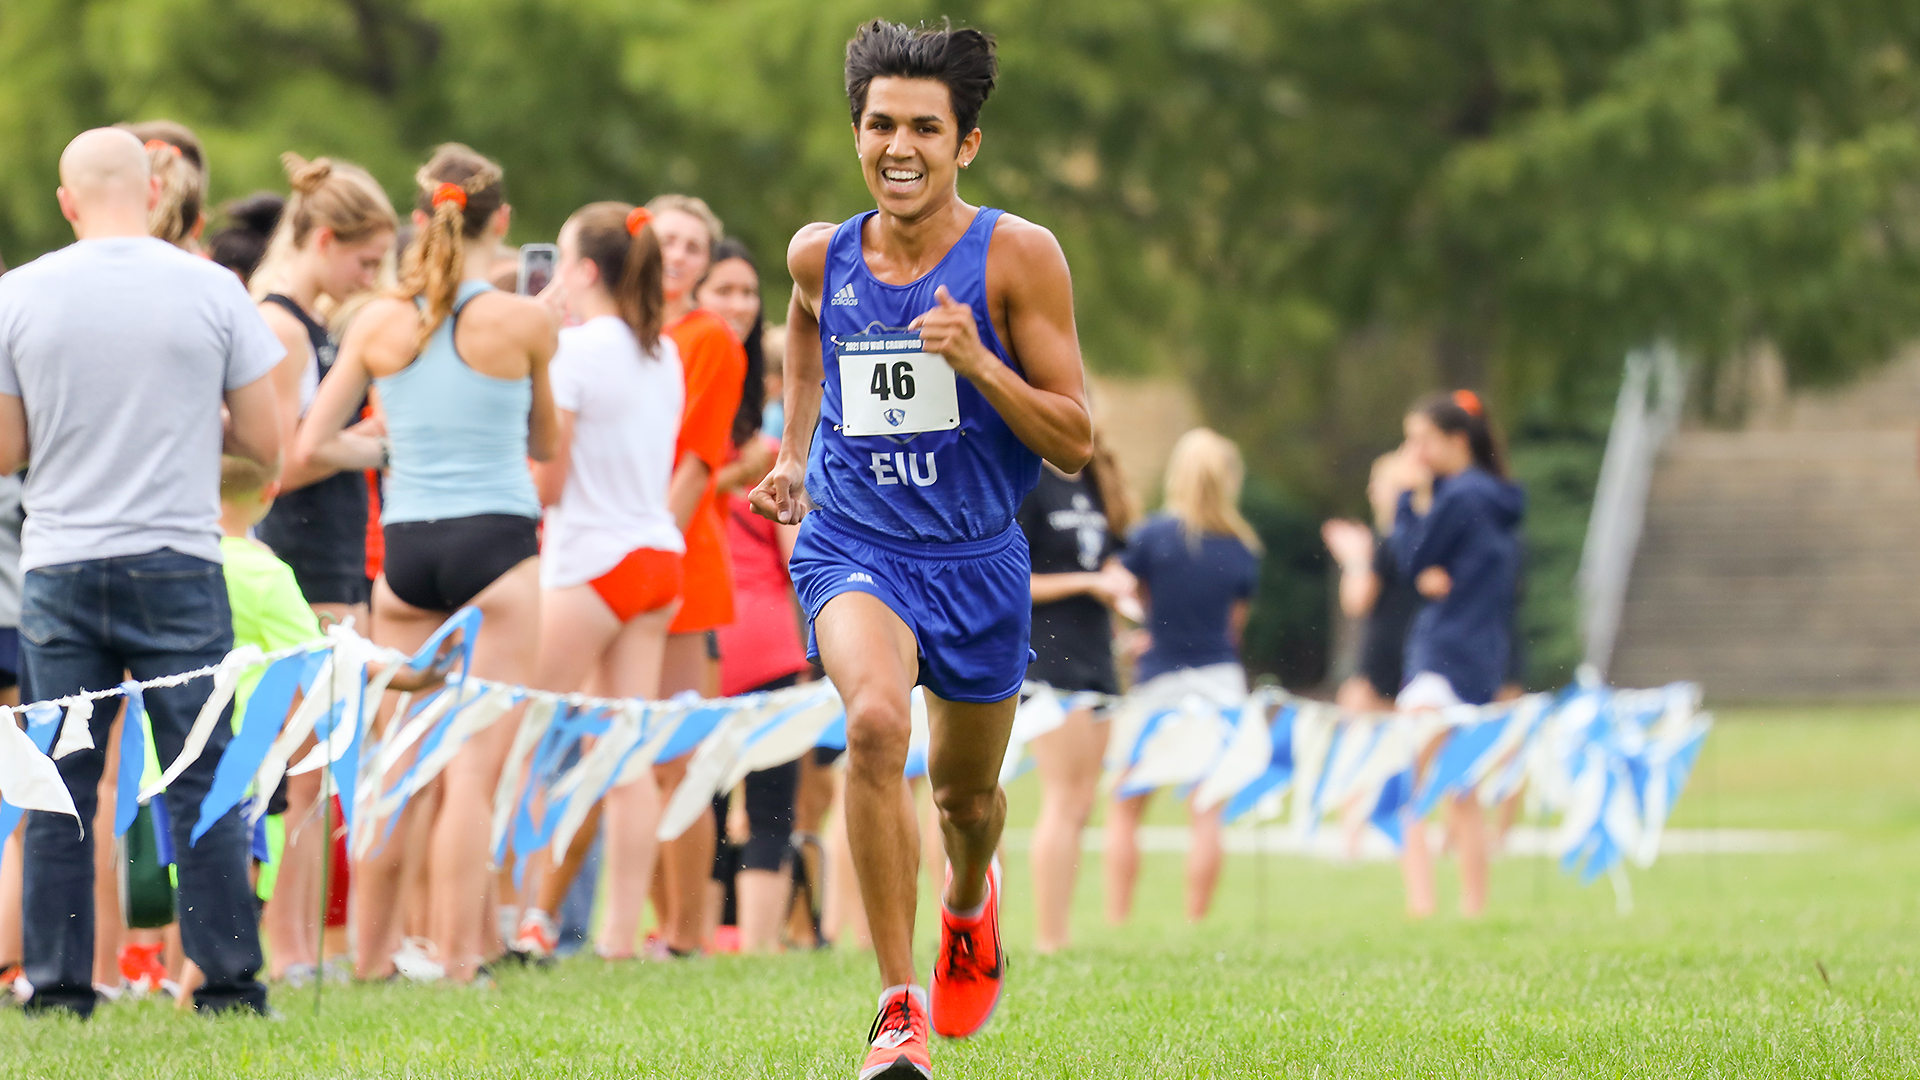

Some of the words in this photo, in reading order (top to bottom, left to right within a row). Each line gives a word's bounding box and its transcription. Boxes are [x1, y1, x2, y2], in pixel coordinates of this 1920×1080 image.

[831, 298, 859, 306] adidas
[885, 339, 922, 350] CRAWFORD
[870, 361, 916, 401] 46
[869, 452, 938, 487] EIU
